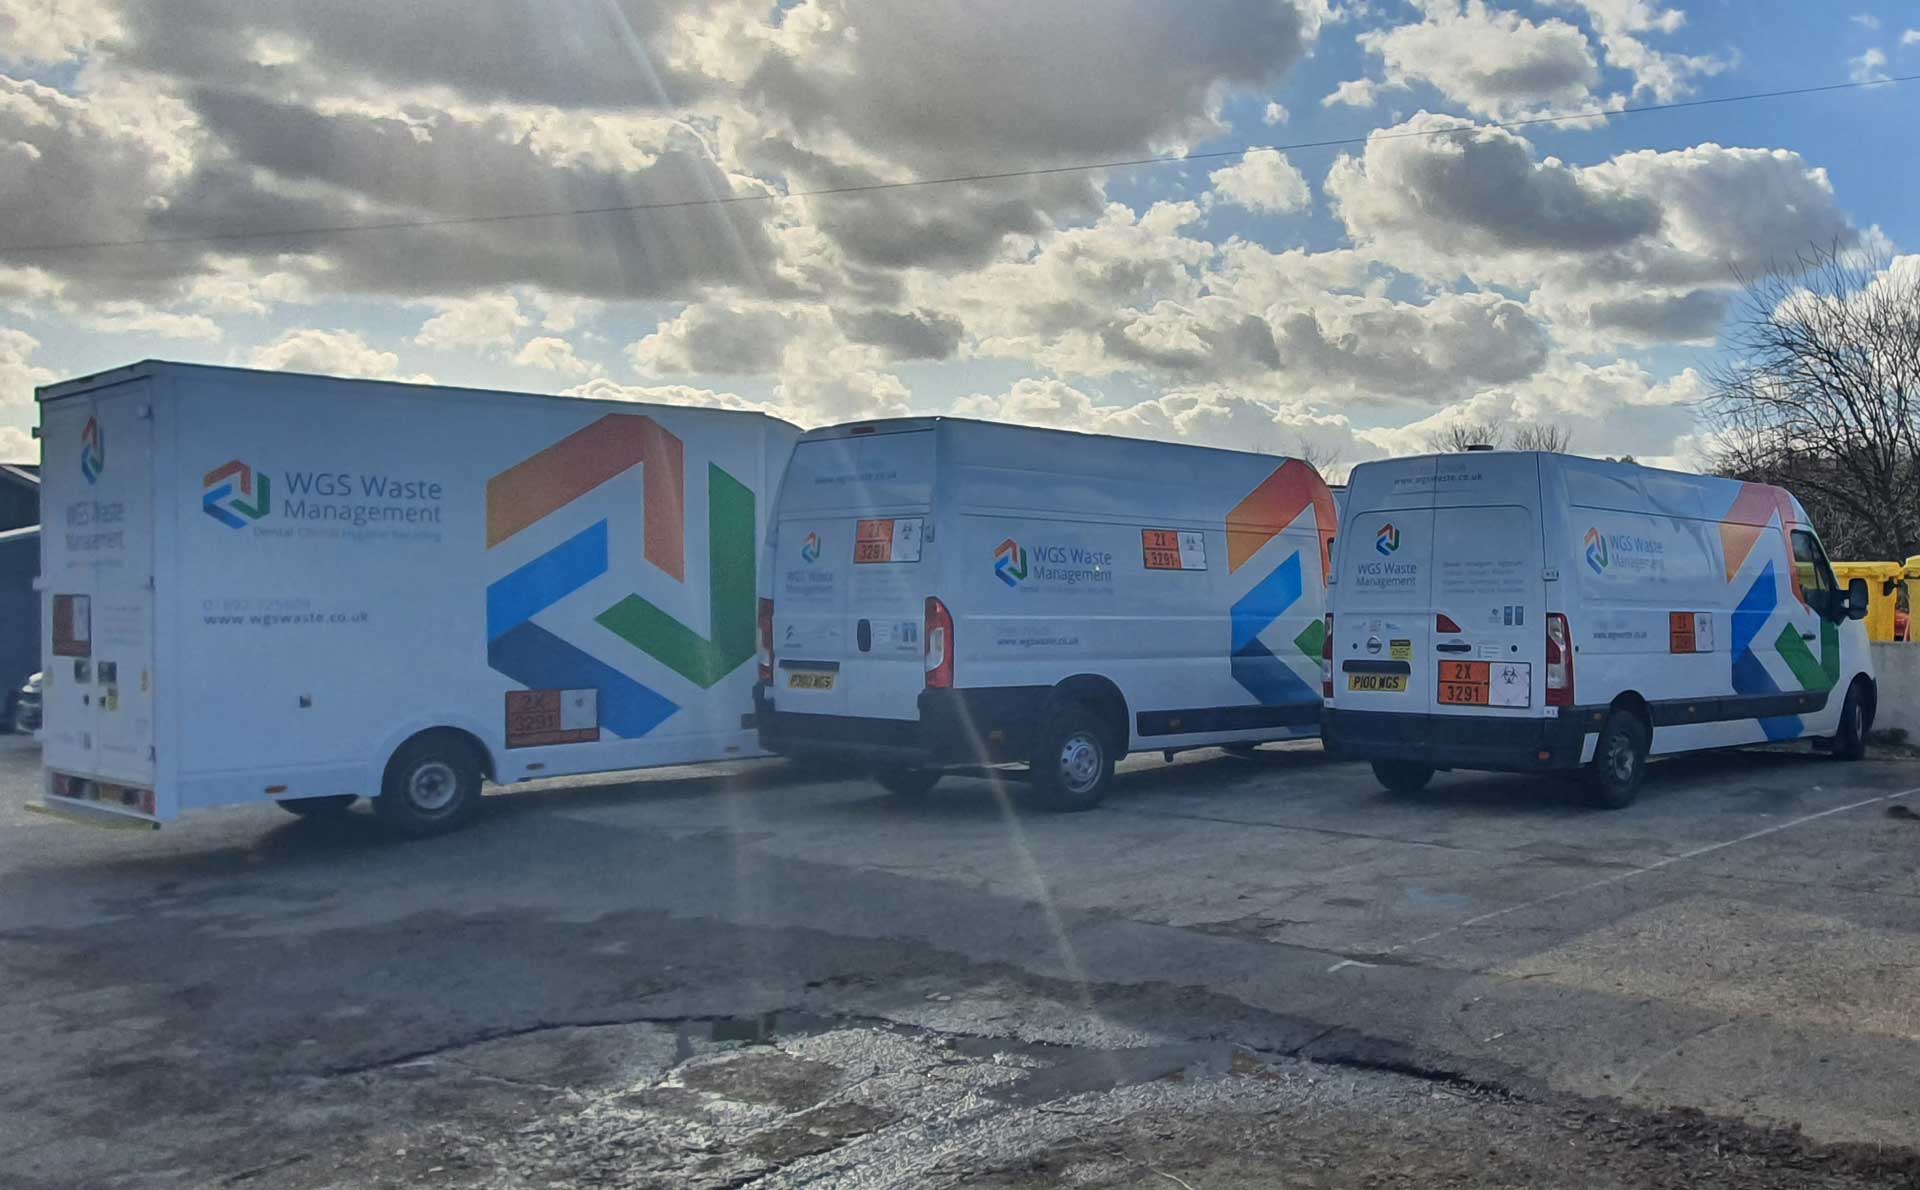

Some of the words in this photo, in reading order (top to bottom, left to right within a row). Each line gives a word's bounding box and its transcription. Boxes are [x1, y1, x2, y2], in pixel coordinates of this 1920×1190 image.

[284, 472, 352, 497] WGS
[360, 475, 442, 500] Waste
[284, 500, 441, 526] Management
[1609, 535, 1633, 551] WGS
[1634, 537, 1664, 554] Waste
[1033, 546, 1066, 563] WGS
[1069, 548, 1112, 565] Waste
[1150, 551, 1175, 567] 3291
[1033, 565, 1112, 585] Management
[1358, 562, 1381, 575] WGS
[1384, 562, 1417, 574] Waste
[1356, 576, 1416, 589] Management
[1456, 663, 1472, 680] 2X
[1353, 675, 1377, 689] P100
[1379, 676, 1400, 689] WGS
[1447, 685, 1480, 702] 3291
